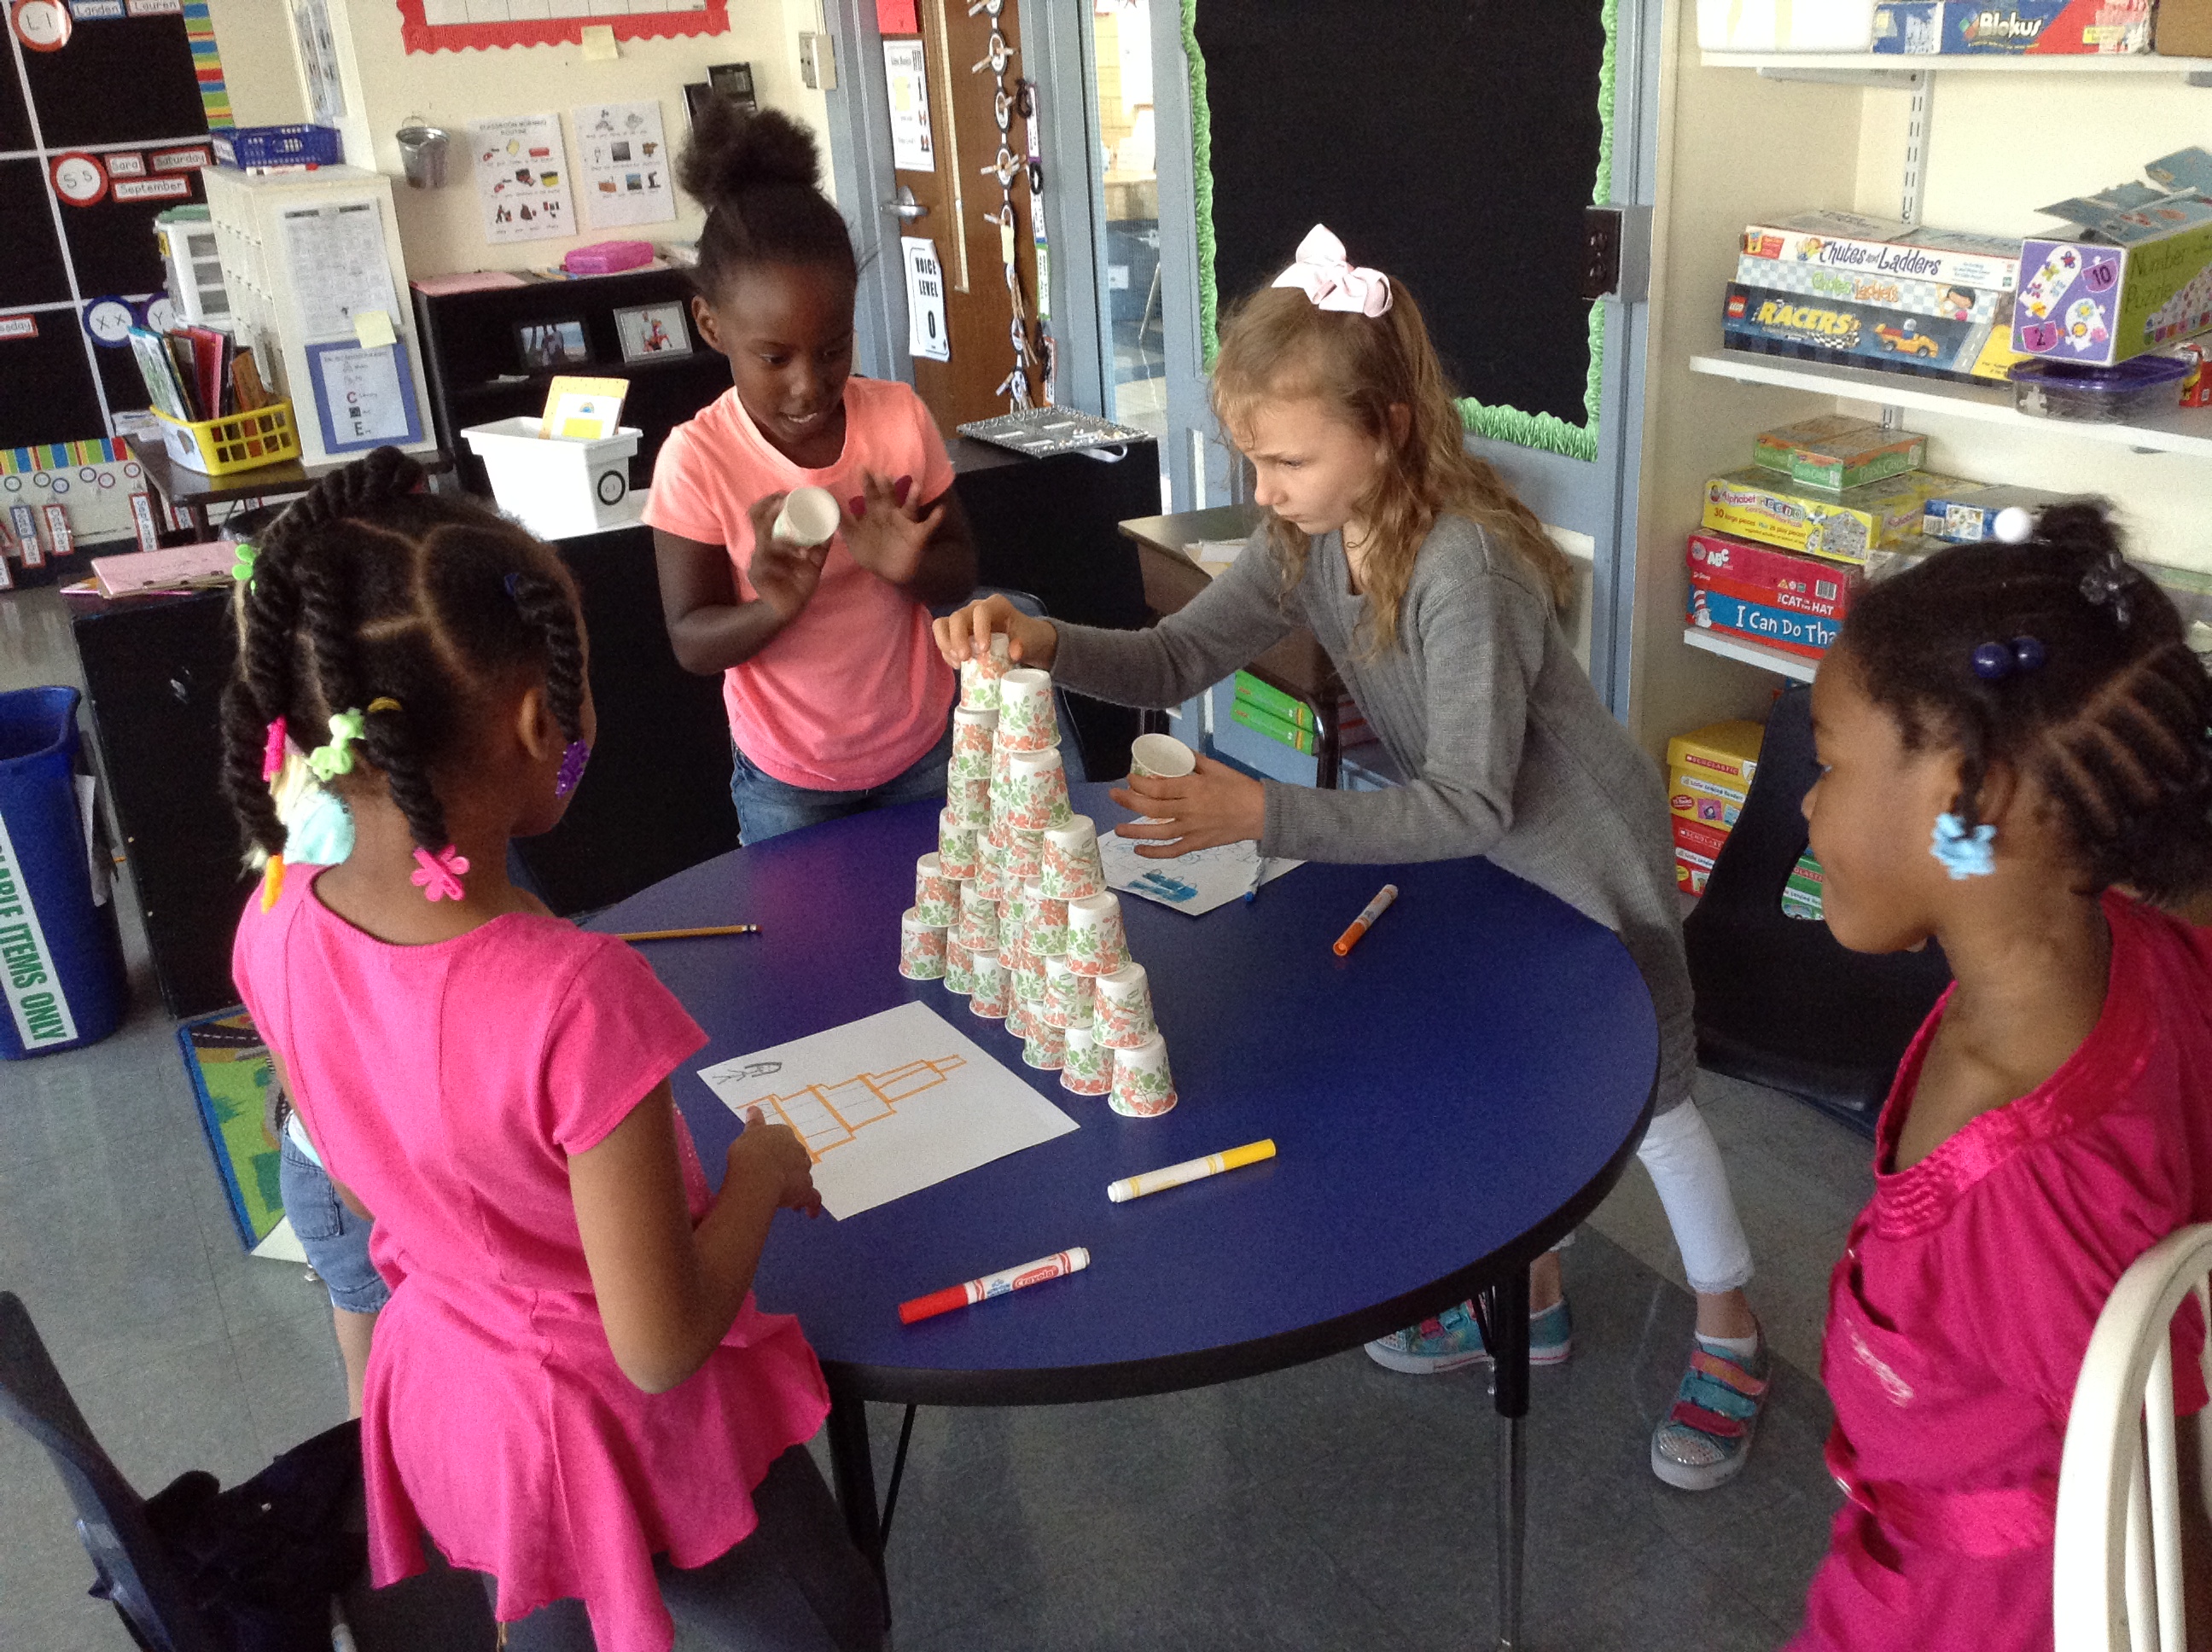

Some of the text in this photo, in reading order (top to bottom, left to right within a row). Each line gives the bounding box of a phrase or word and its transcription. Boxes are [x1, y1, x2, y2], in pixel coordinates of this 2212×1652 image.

[1977, 11, 2043, 39] Blokus
[112, 159, 138, 172] Sara
[155, 153, 205, 167] Saturday
[119, 180, 183, 195] September
[915, 257, 937, 276] VOICE
[1819, 241, 1866, 265] Chutes
[1878, 247, 1941, 275] Ladders
[2093, 265, 2112, 286] 10
[918, 279, 939, 298] LEVEL
[1757, 301, 1853, 335] RACERS
[1722, 491, 1756, 505] Alphabet
[1714, 507, 1725, 518] 30
[1707, 548, 1730, 568] ABC
[1781, 594, 1803, 608] CAT
[1812, 602, 1834, 616] HAT
[1736, 605, 1746, 628] I
[1749, 612, 1778, 635] Can
[1782, 619, 1802, 637] Do
[1691, 755, 1739, 775] SCHOLASTIC
[0, 922, 48, 990] ITEMS
[20, 992, 67, 1041] ONLY
[1015, 1268, 1055, 1287] Crayola
